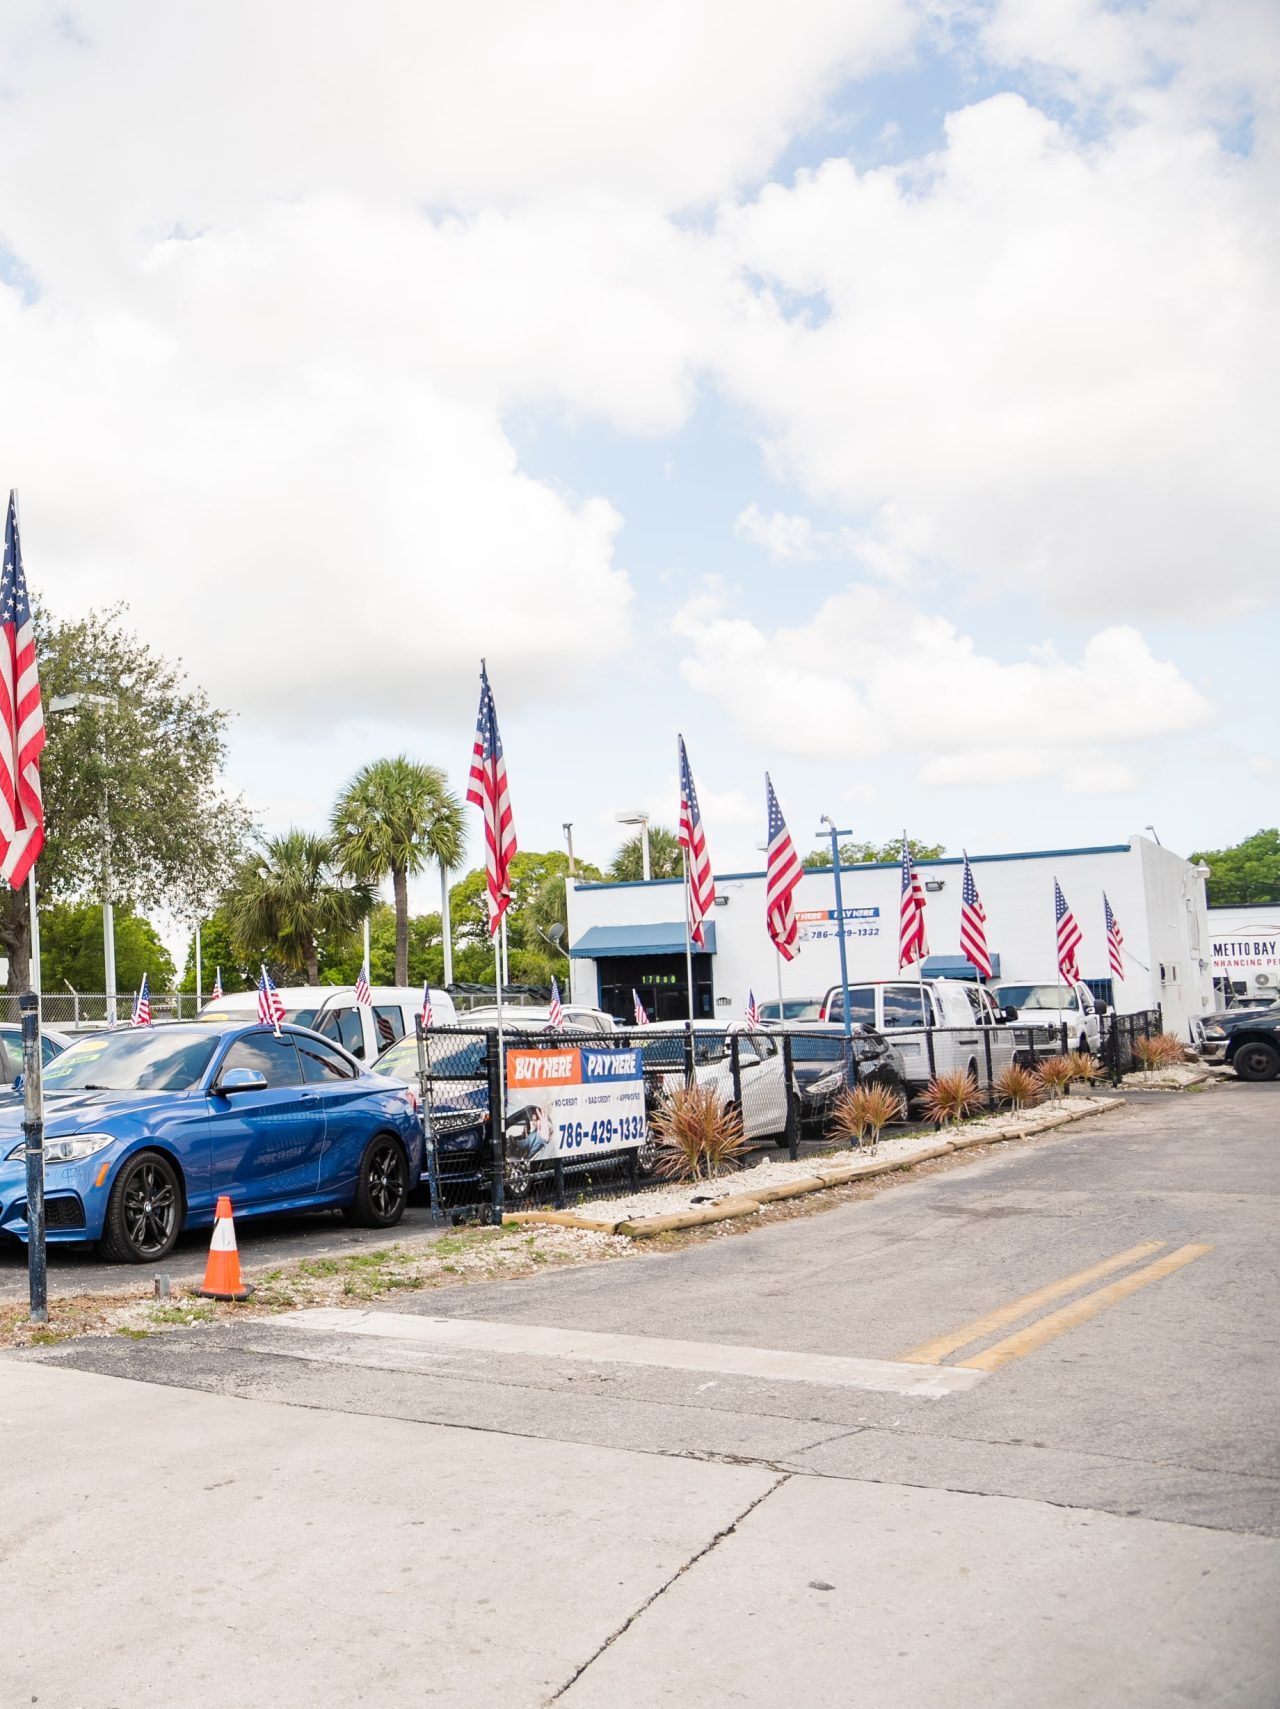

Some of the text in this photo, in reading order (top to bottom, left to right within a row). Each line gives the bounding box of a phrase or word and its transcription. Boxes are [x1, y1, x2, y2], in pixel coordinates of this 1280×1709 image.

[1253, 941, 1276, 955] BAY
[515, 1056, 573, 1080] BUY HERE
[587, 1053, 636, 1076] PAY HERE
[559, 1115, 644, 1150] 786-429-1332
